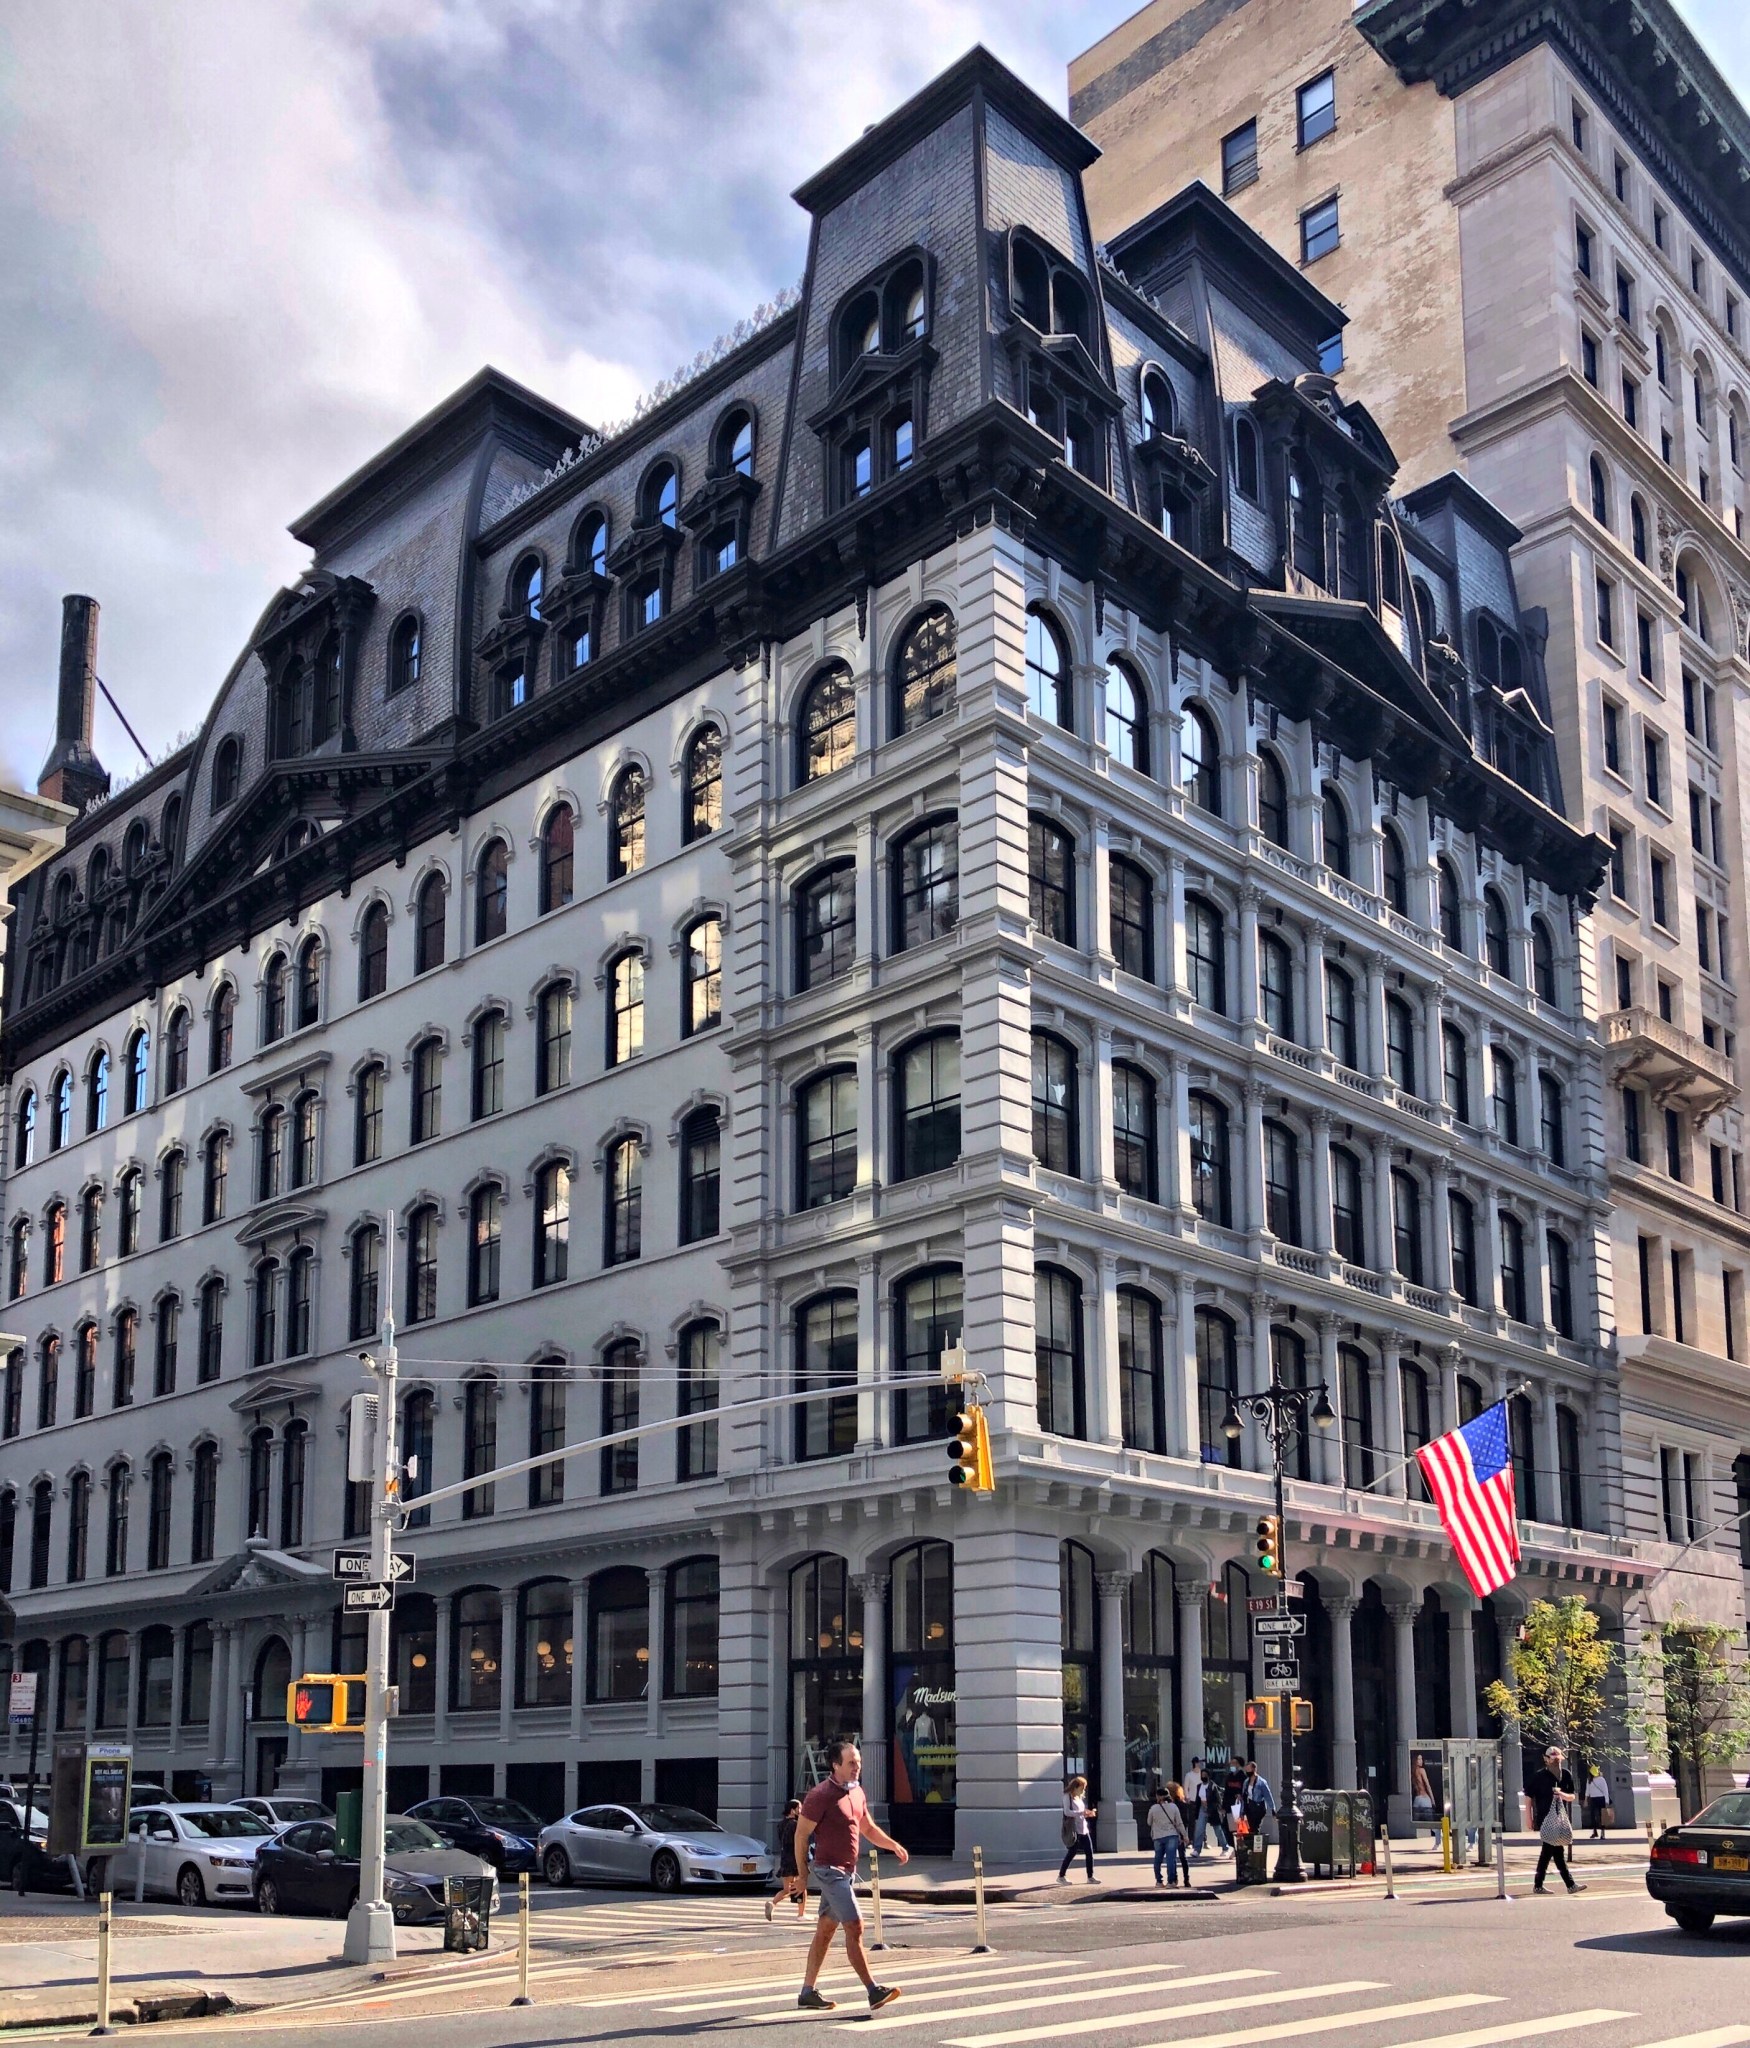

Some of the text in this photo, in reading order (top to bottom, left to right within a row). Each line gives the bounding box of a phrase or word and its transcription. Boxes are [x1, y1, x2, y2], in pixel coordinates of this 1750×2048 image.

[346, 1560, 369, 1571] ONE
[351, 1591, 386, 1603] ONE WAY
[1249, 1600, 1254, 1611] E
[1256, 1599, 1264, 1610] 19
[1262, 1621, 1297, 1631] ONE WAY
[13, 1674, 20, 1682] 3
